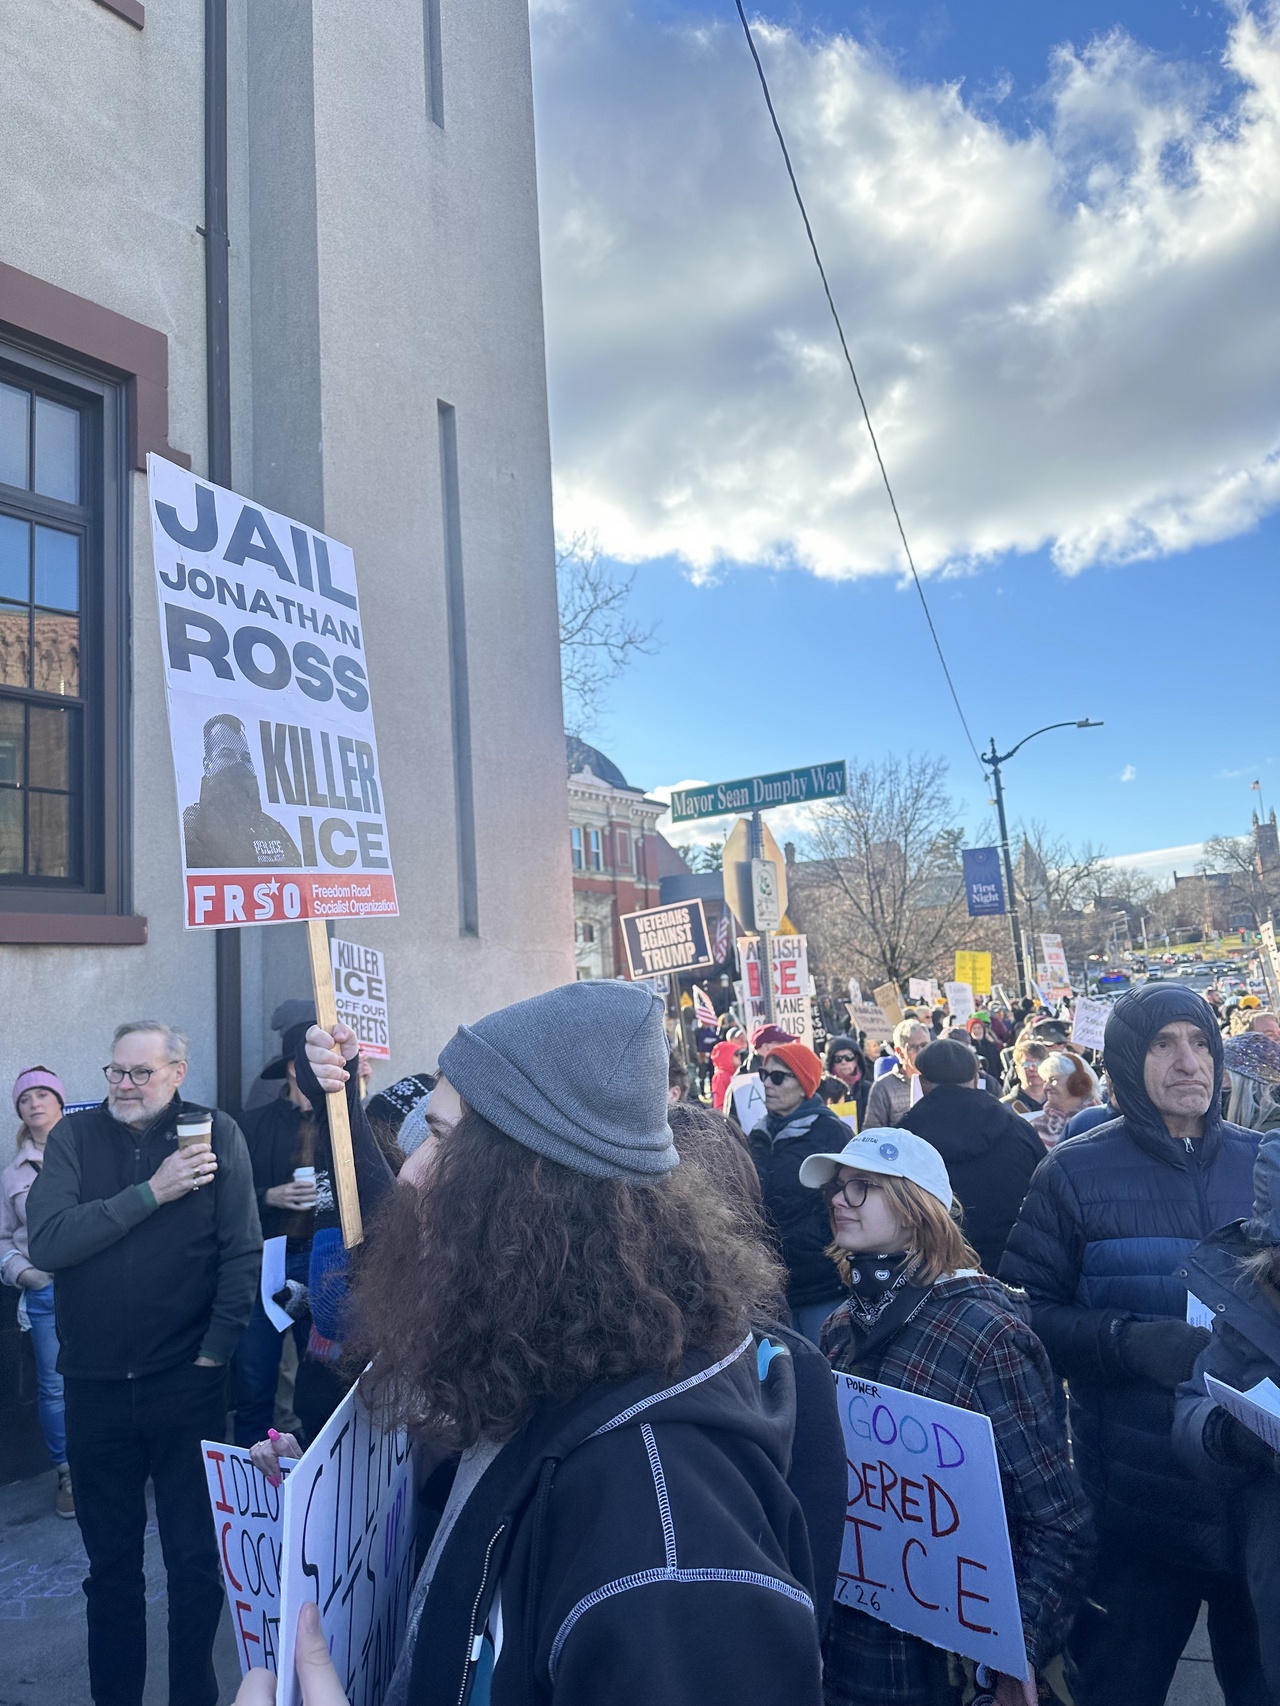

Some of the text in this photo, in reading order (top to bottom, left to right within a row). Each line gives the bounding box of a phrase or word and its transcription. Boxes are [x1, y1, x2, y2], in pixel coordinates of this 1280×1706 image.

[155, 483, 357, 611] JAIL
[159, 562, 361, 649] JONATHAN
[165, 602, 369, 712] ROSS
[259, 719, 381, 814] KILLER
[673, 766, 843, 818] Mayor Sean Dunphy Way
[298, 815, 389, 868] ICE
[194, 882, 301, 923] FRSO
[312, 884, 371, 898] Freedom Road
[972, 883, 996, 893] First
[972, 892, 999, 904] Night
[314, 898, 396, 915] Socialist Organization
[635, 907, 691, 933] VETERANS
[640, 923, 693, 951] AGAINST
[747, 938, 801, 960] ALISH
[338, 941, 379, 976] KILLER
[642, 942, 696, 971] TRUMP
[335, 967, 384, 1002] ICE
[747, 960, 800, 996] IE
[336, 999, 386, 1017] OFF OUR
[846, 1377, 881, 1398] POWER
[848, 1395, 965, 1468] GOOD
[847, 1459, 960, 1538] DERED
[385, 1476, 407, 1578] UP!
